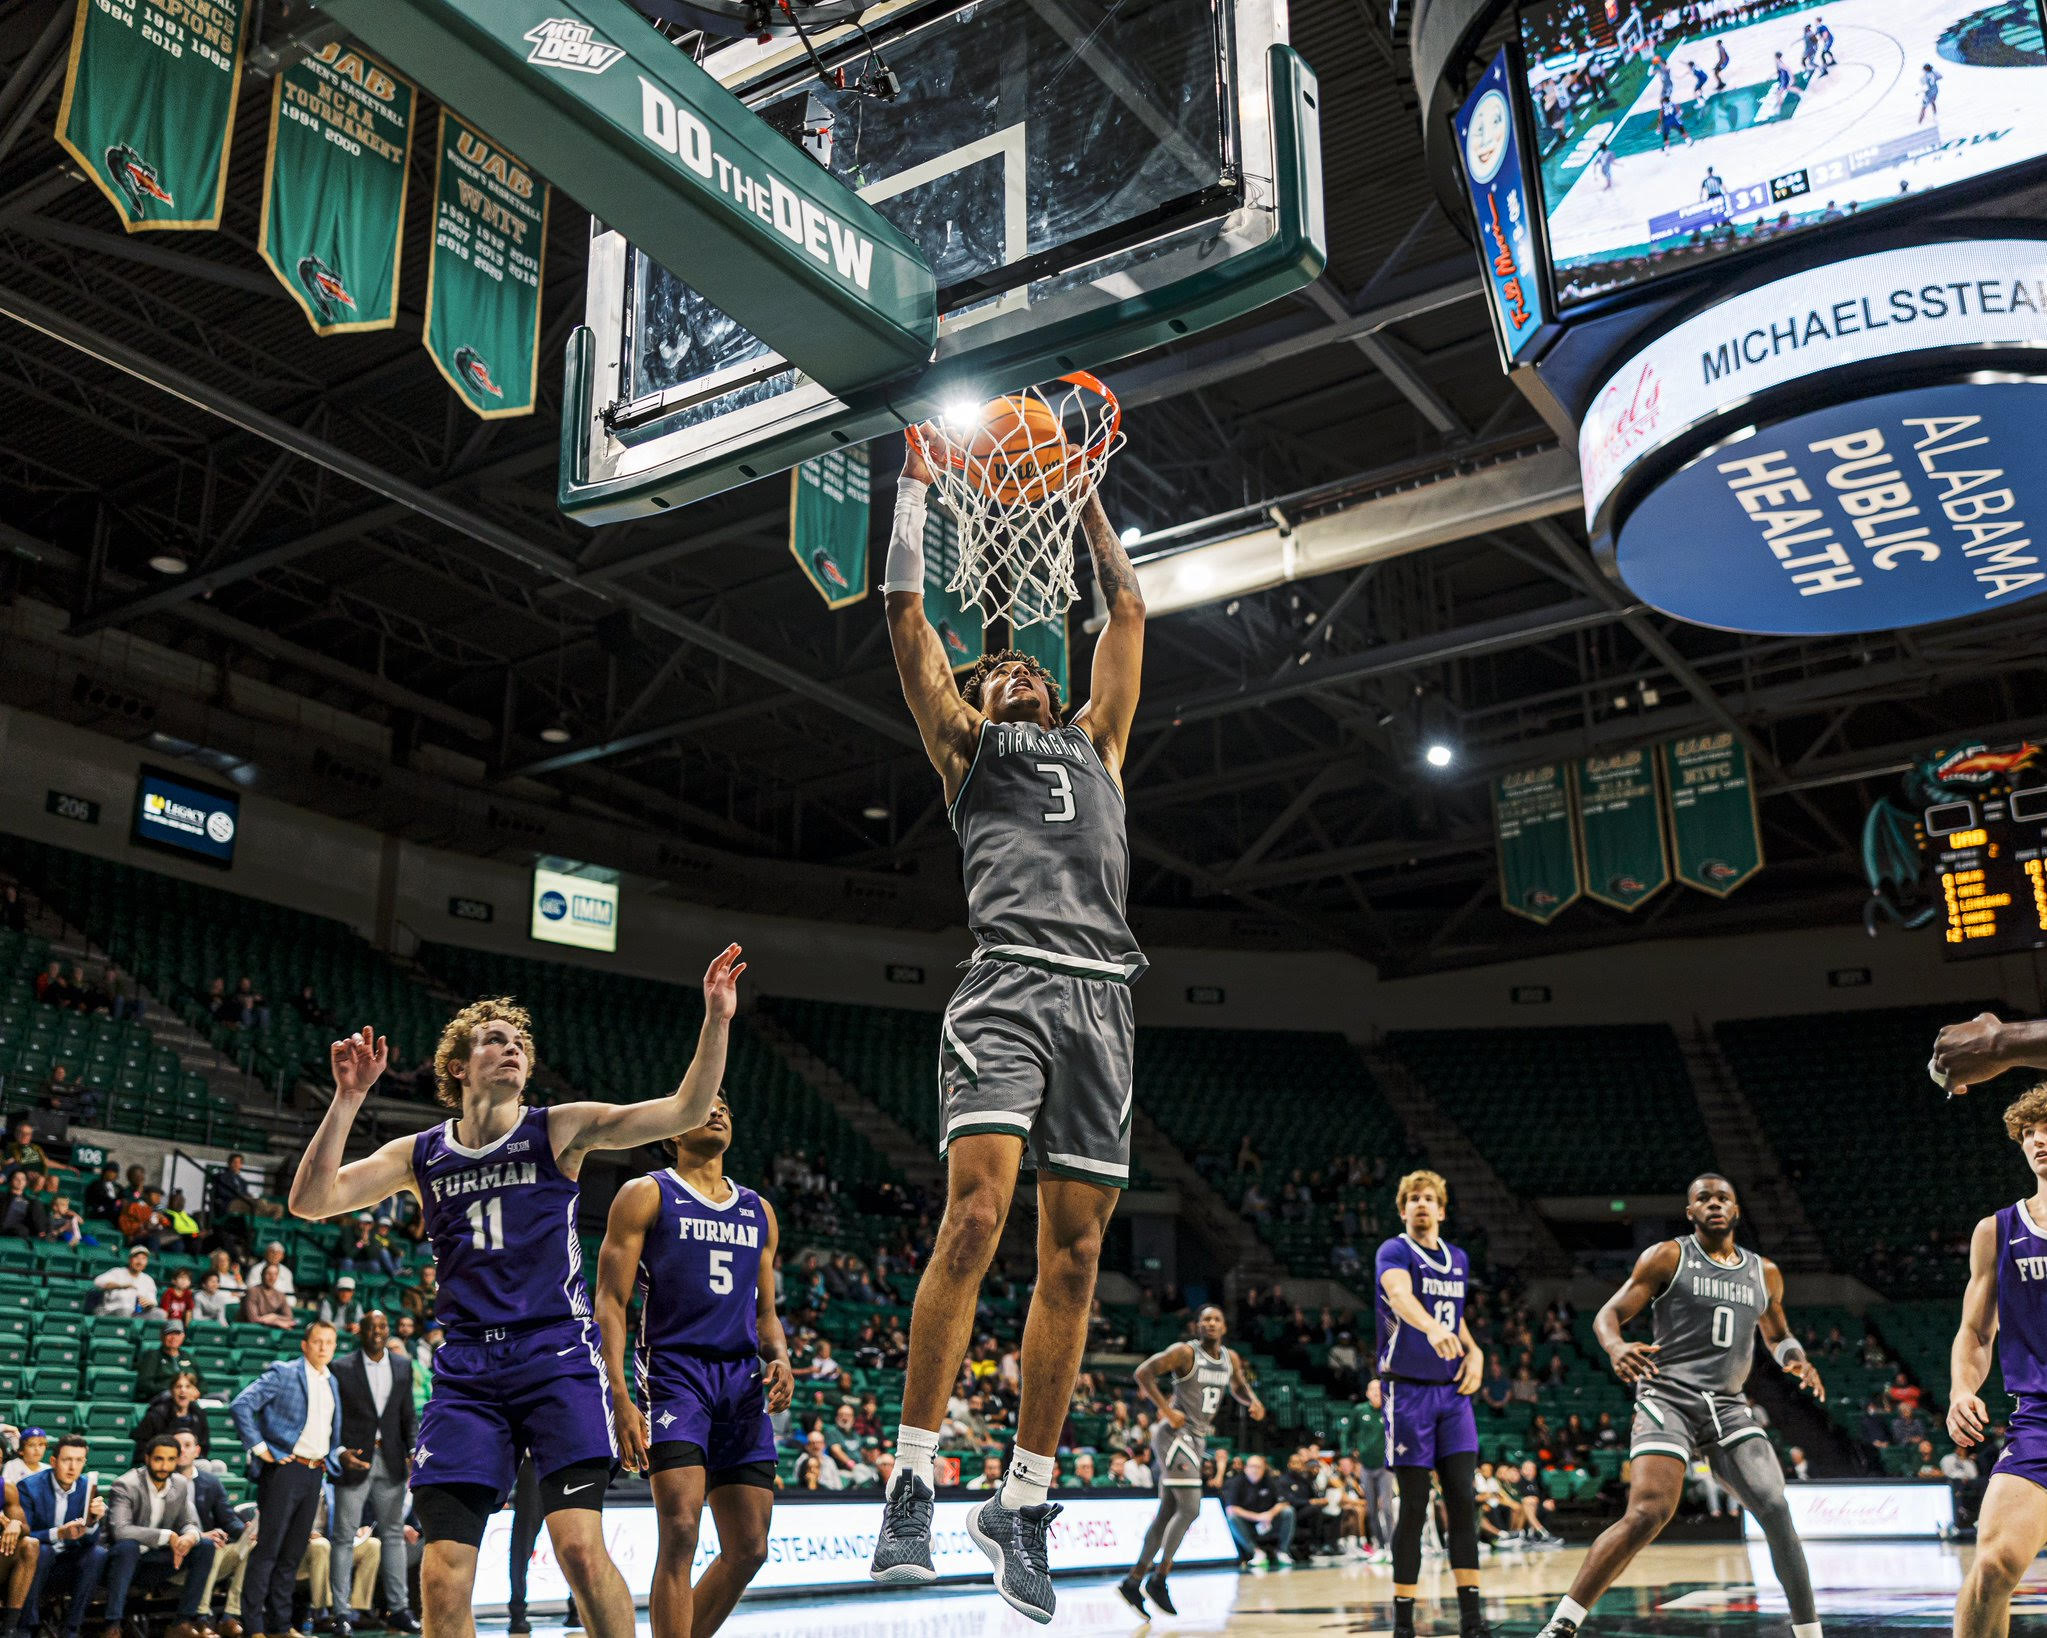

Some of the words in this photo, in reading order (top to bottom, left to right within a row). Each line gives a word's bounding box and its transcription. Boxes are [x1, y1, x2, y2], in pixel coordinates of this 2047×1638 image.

[284, 80, 403, 164] TOURNAMENT
[317, 80, 375, 130] NCAA
[456, 130, 535, 199] UAB
[637, 75, 714, 179] DO
[712, 152, 773, 225] THE
[766, 173, 874, 291] DEW
[457, 177, 528, 245] WNIT
[1735, 186, 1764, 210] 31
[993, 458, 1061, 481] Wilon
[1716, 449, 1864, 597] HEALTH
[1808, 427, 1942, 571] PUBLIC
[1901, 415, 2047, 600] ALABAMA
[1035, 762, 1077, 823] 3
[430, 1161, 537, 1203] FURMAN
[466, 1196, 505, 1251] 11
[679, 1216, 759, 1249] FURMAN
[709, 1249, 734, 1295] 5
[1692, 1275, 1755, 1307] BIRMINGHAM
[2015, 1255, 2047, 1282] FU
[484, 1326, 507, 1343] FU
[1433, 1299, 1456, 1332] 13
[1711, 1304, 1735, 1349] 0
